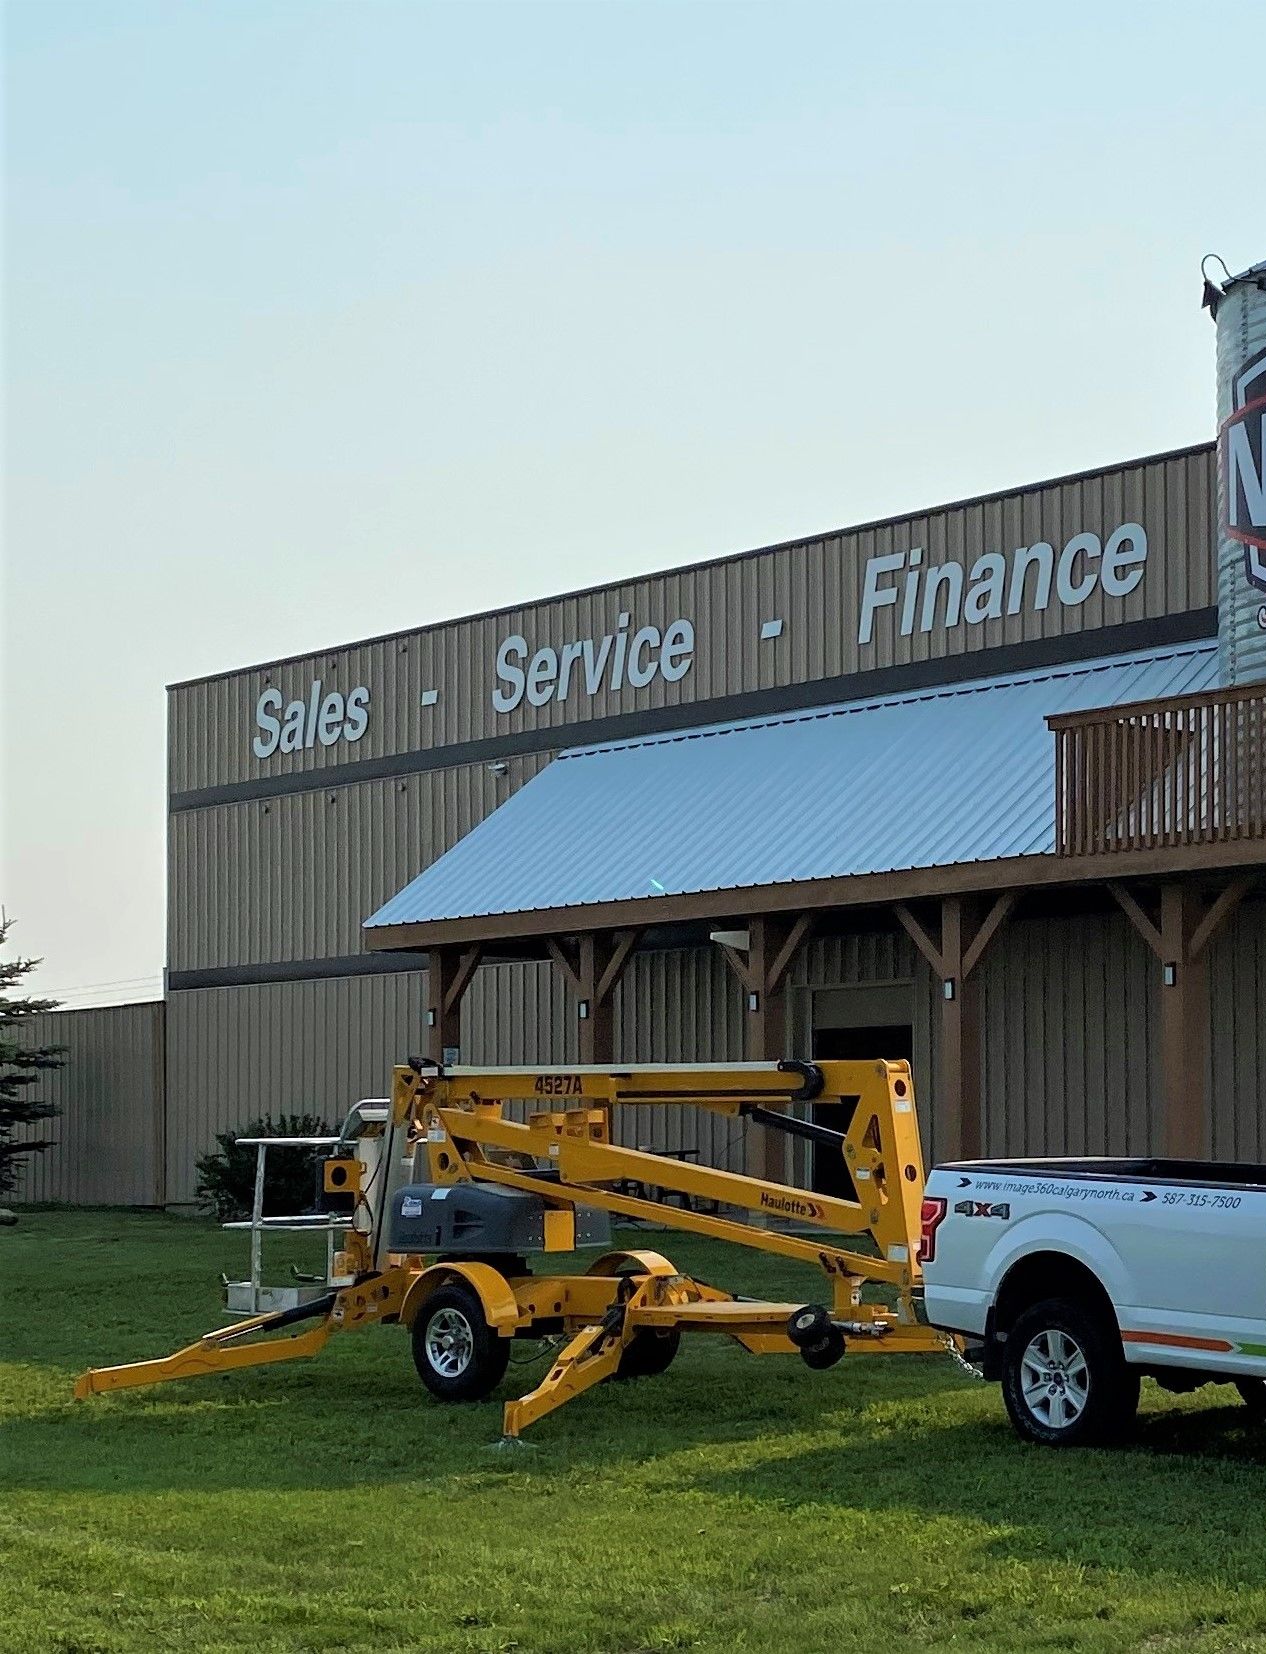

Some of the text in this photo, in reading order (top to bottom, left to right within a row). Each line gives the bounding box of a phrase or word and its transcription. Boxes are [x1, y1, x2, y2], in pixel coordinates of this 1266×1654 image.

[252, 682, 371, 760] Sales
[491, 612, 695, 714] Service
[856, 521, 1148, 645] Finance
[535, 1075, 583, 1095] 4527A
[761, 1192, 807, 1216] Haulotte
[975, 1180, 1242, 1209] www.image360calgarynorth.ca 587-315-7500
